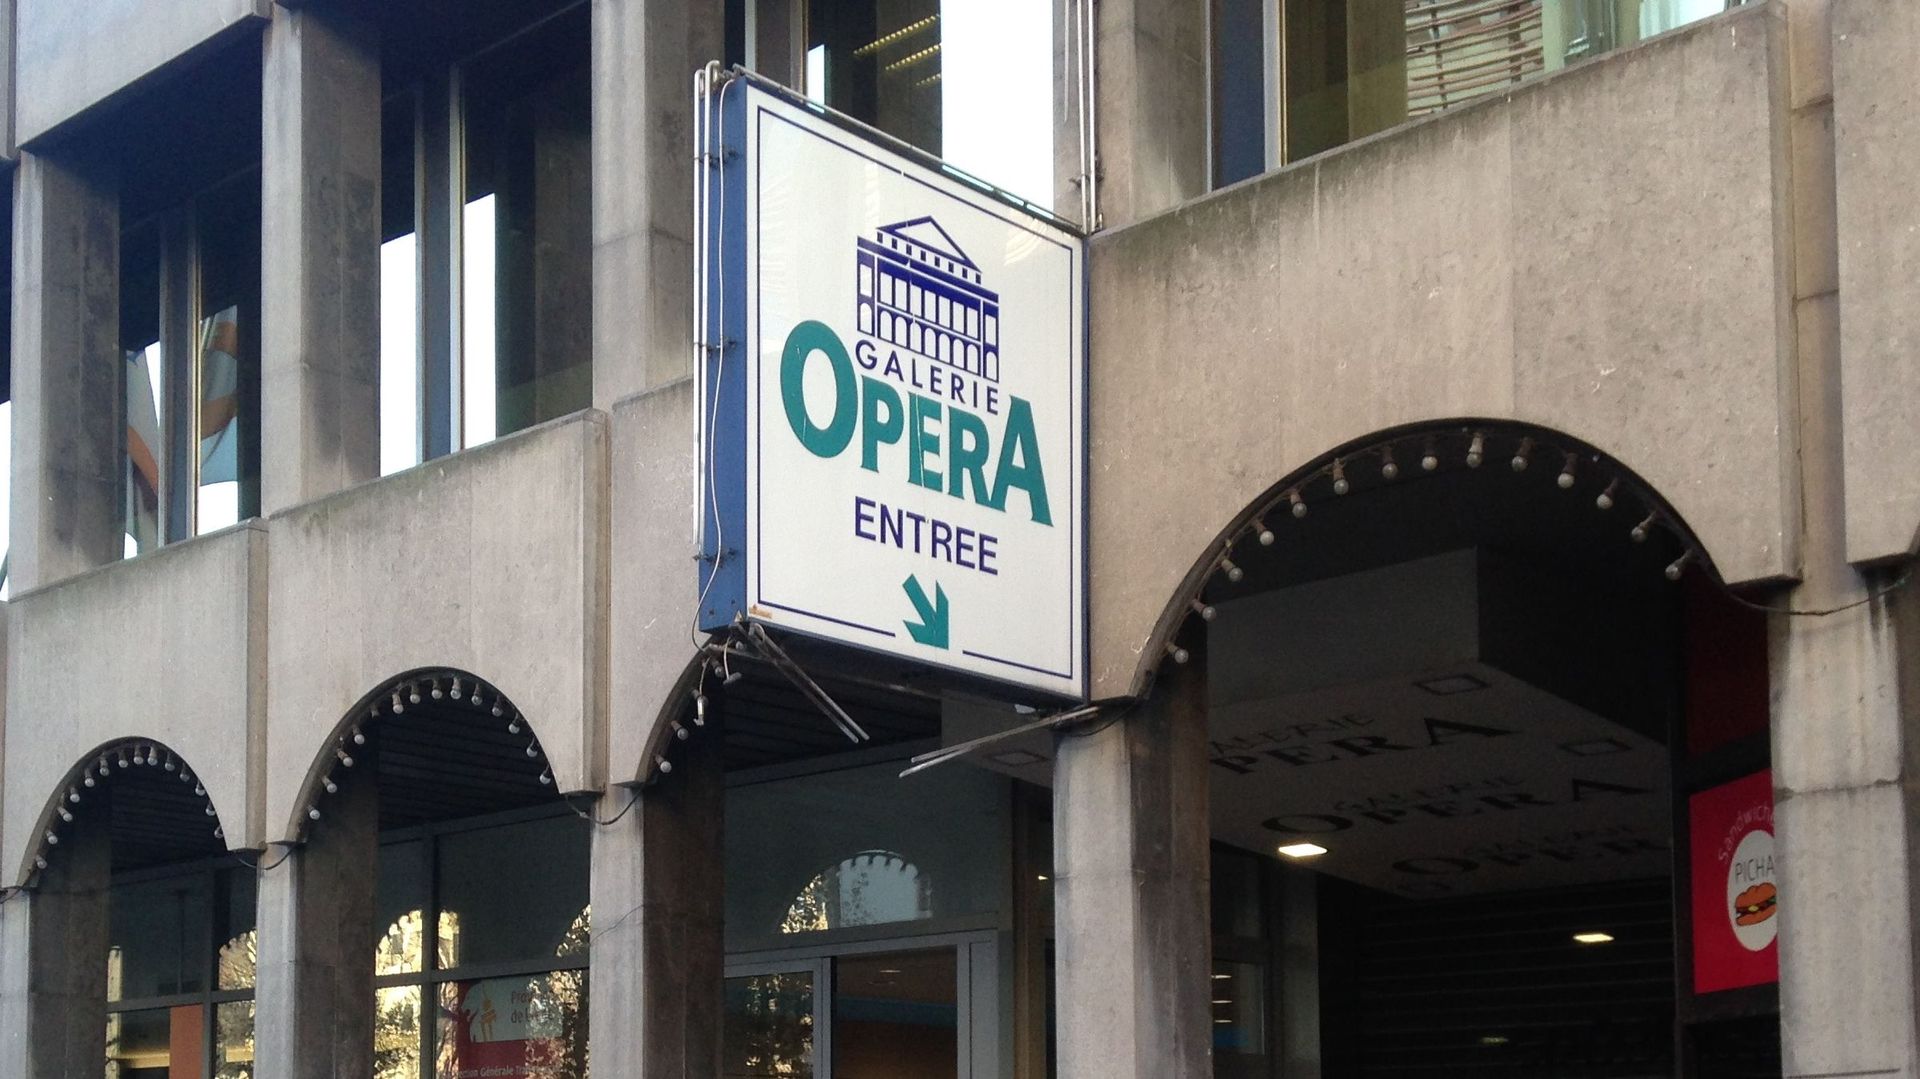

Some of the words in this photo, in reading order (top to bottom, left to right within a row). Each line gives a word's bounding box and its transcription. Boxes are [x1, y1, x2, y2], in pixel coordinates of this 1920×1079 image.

[855, 339, 999, 415] GALERIE
[780, 319, 1054, 527] OPERA
[855, 495, 998, 575] ENTREE
[1210, 712, 1375, 754] ALERIE
[1210, 717, 1521, 775] PERA
